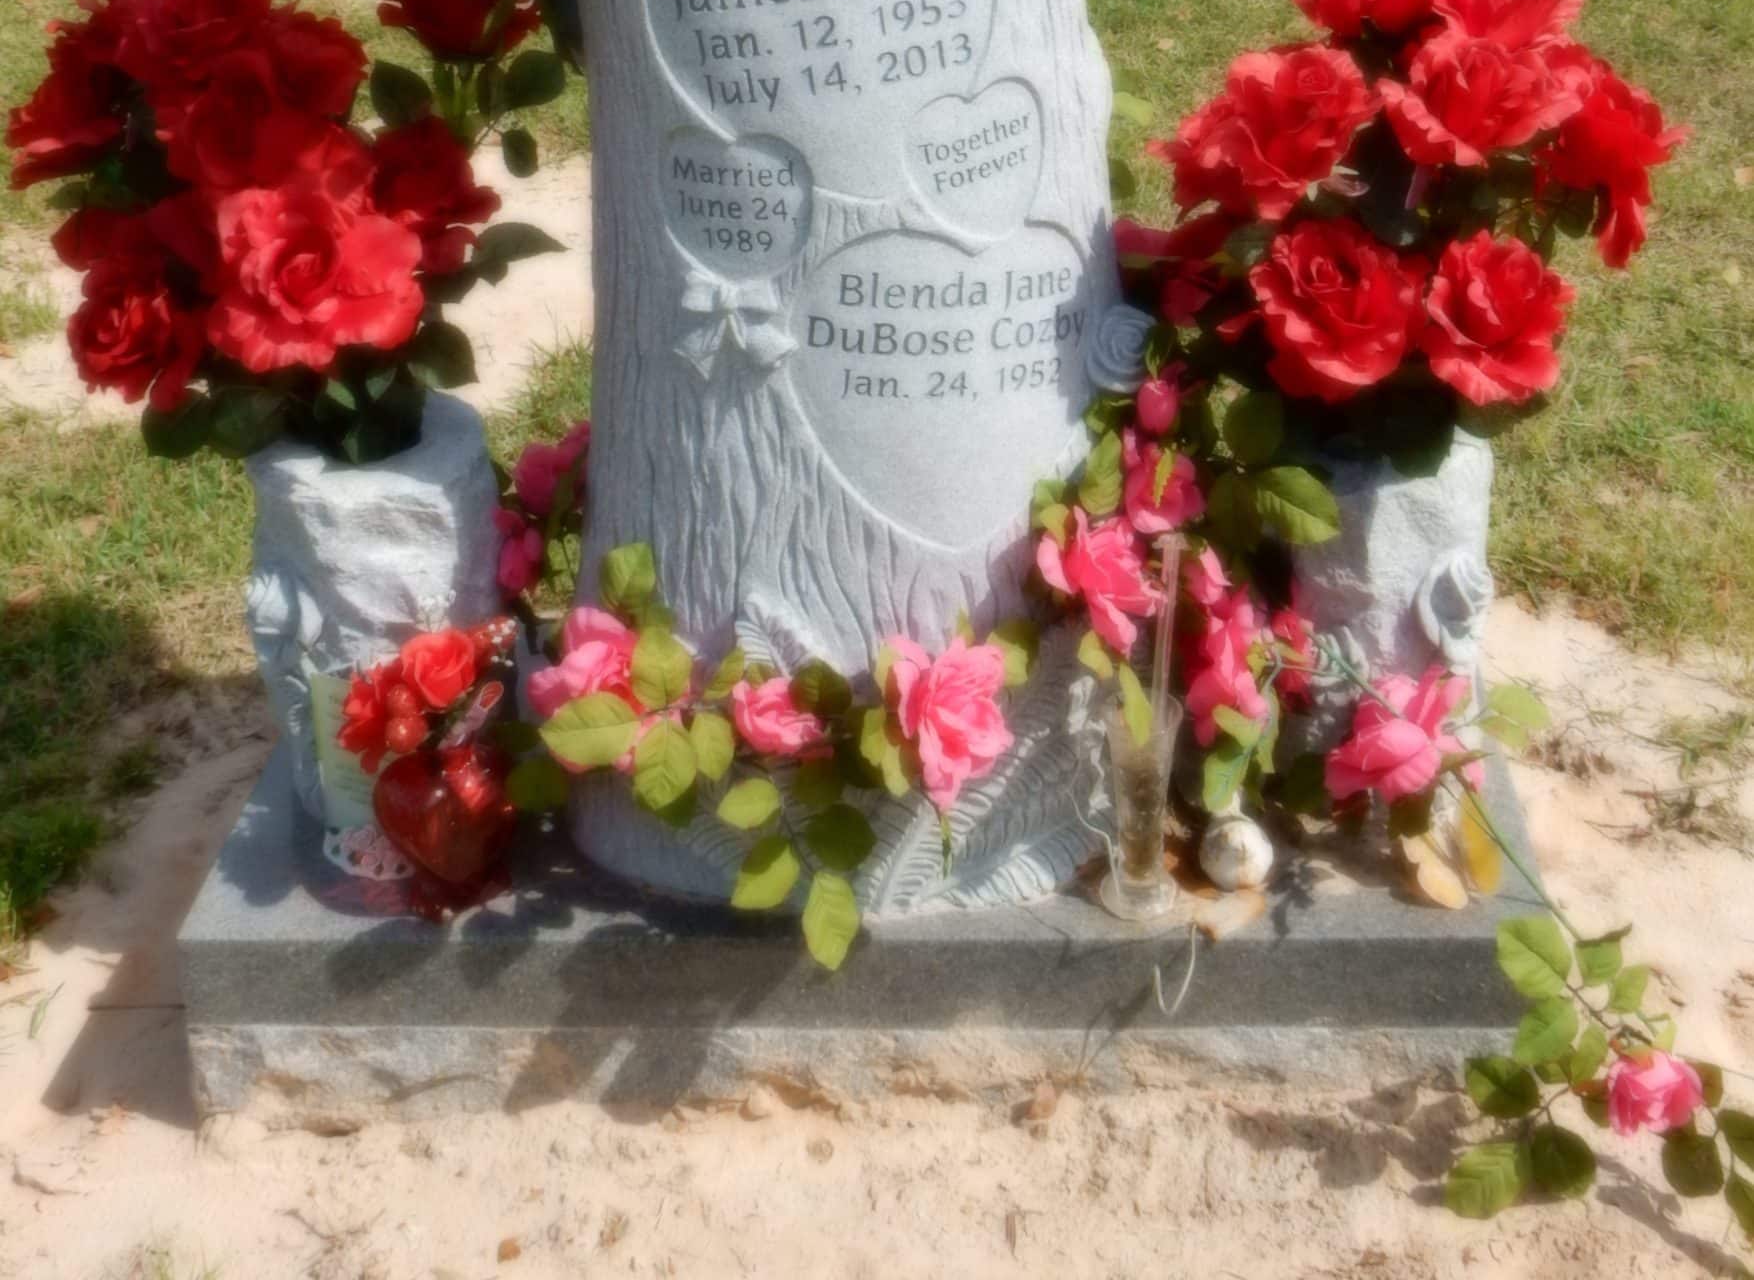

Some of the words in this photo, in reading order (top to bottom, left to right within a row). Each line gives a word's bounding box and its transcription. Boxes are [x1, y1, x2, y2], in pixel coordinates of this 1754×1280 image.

[694, 29, 774, 66] Jan.
[792, 16, 855, 51] 12,
[703, 69, 781, 112] July
[801, 61, 863, 96] 14,
[877, 33, 973, 83] 2013
[918, 112, 1031, 165] Together
[673, 156, 795, 188] Married
[933, 144, 1029, 194] Forever
[678, 189, 743, 220] June
[751, 197, 798, 232] 24,
[702, 227, 774, 253] 1989
[839, 272, 988, 310] Blenda
[1003, 267, 1072, 312] Jane
[807, 315, 975, 356] DuBose
[990, 304, 1087, 353] Cozby
[841, 368, 910, 401] Jan.
[927, 370, 978, 402] 24,
[997, 357, 1063, 394] 1952
